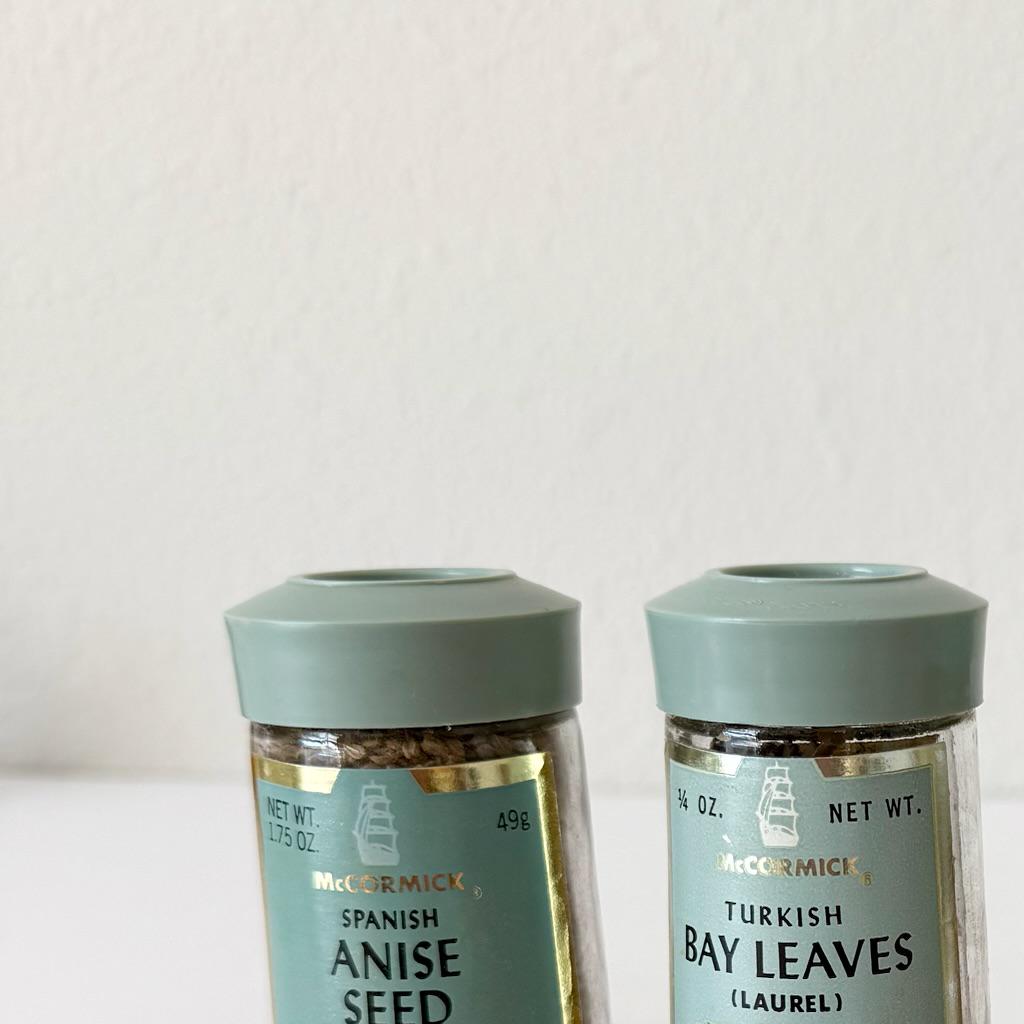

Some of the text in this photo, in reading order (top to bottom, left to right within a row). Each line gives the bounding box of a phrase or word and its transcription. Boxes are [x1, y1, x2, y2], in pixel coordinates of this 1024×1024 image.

[267, 796, 320, 828] NET WT.
[698, 795, 723, 818] OZ.
[829, 795, 922, 823] NET WT.
[497, 809, 531, 831] 49g
[296, 830, 319, 853] OZ.
[342, 908, 439, 930] SPANISH
[725, 901, 842, 927] TURKISH
[331, 938, 461, 980] ANISE
[685, 925, 913, 979] BAY LEAVES
[731, 989, 843, 1012] (LAUREL)
